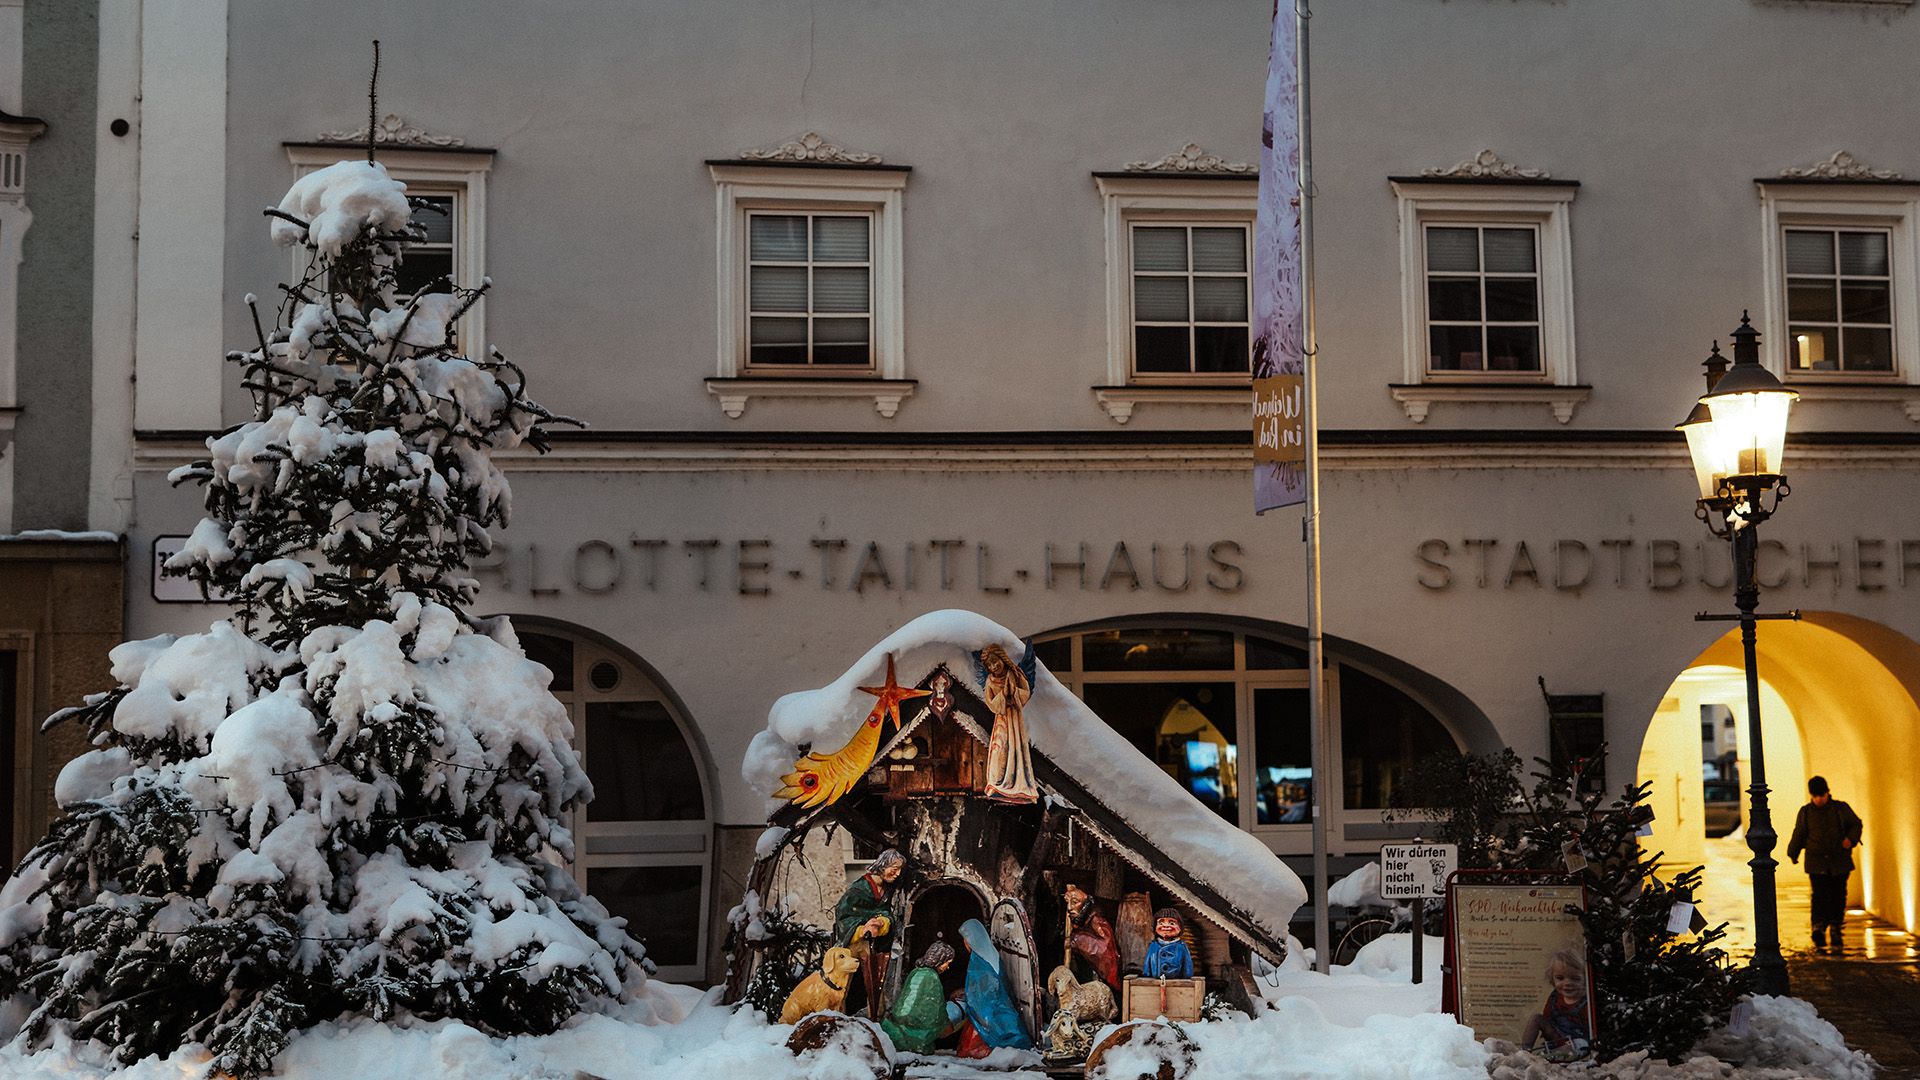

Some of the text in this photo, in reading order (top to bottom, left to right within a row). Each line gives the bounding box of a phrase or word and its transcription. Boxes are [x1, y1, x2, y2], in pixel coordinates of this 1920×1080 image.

[471, 539, 1244, 592] RLOTTE-TAITL-HAUS
[1385, 845, 1446, 858] Wir dürfen
[1385, 860, 1408, 870] hier
[1385, 872, 1414, 883] nicht
[1385, 884, 1425, 895] hinein!
